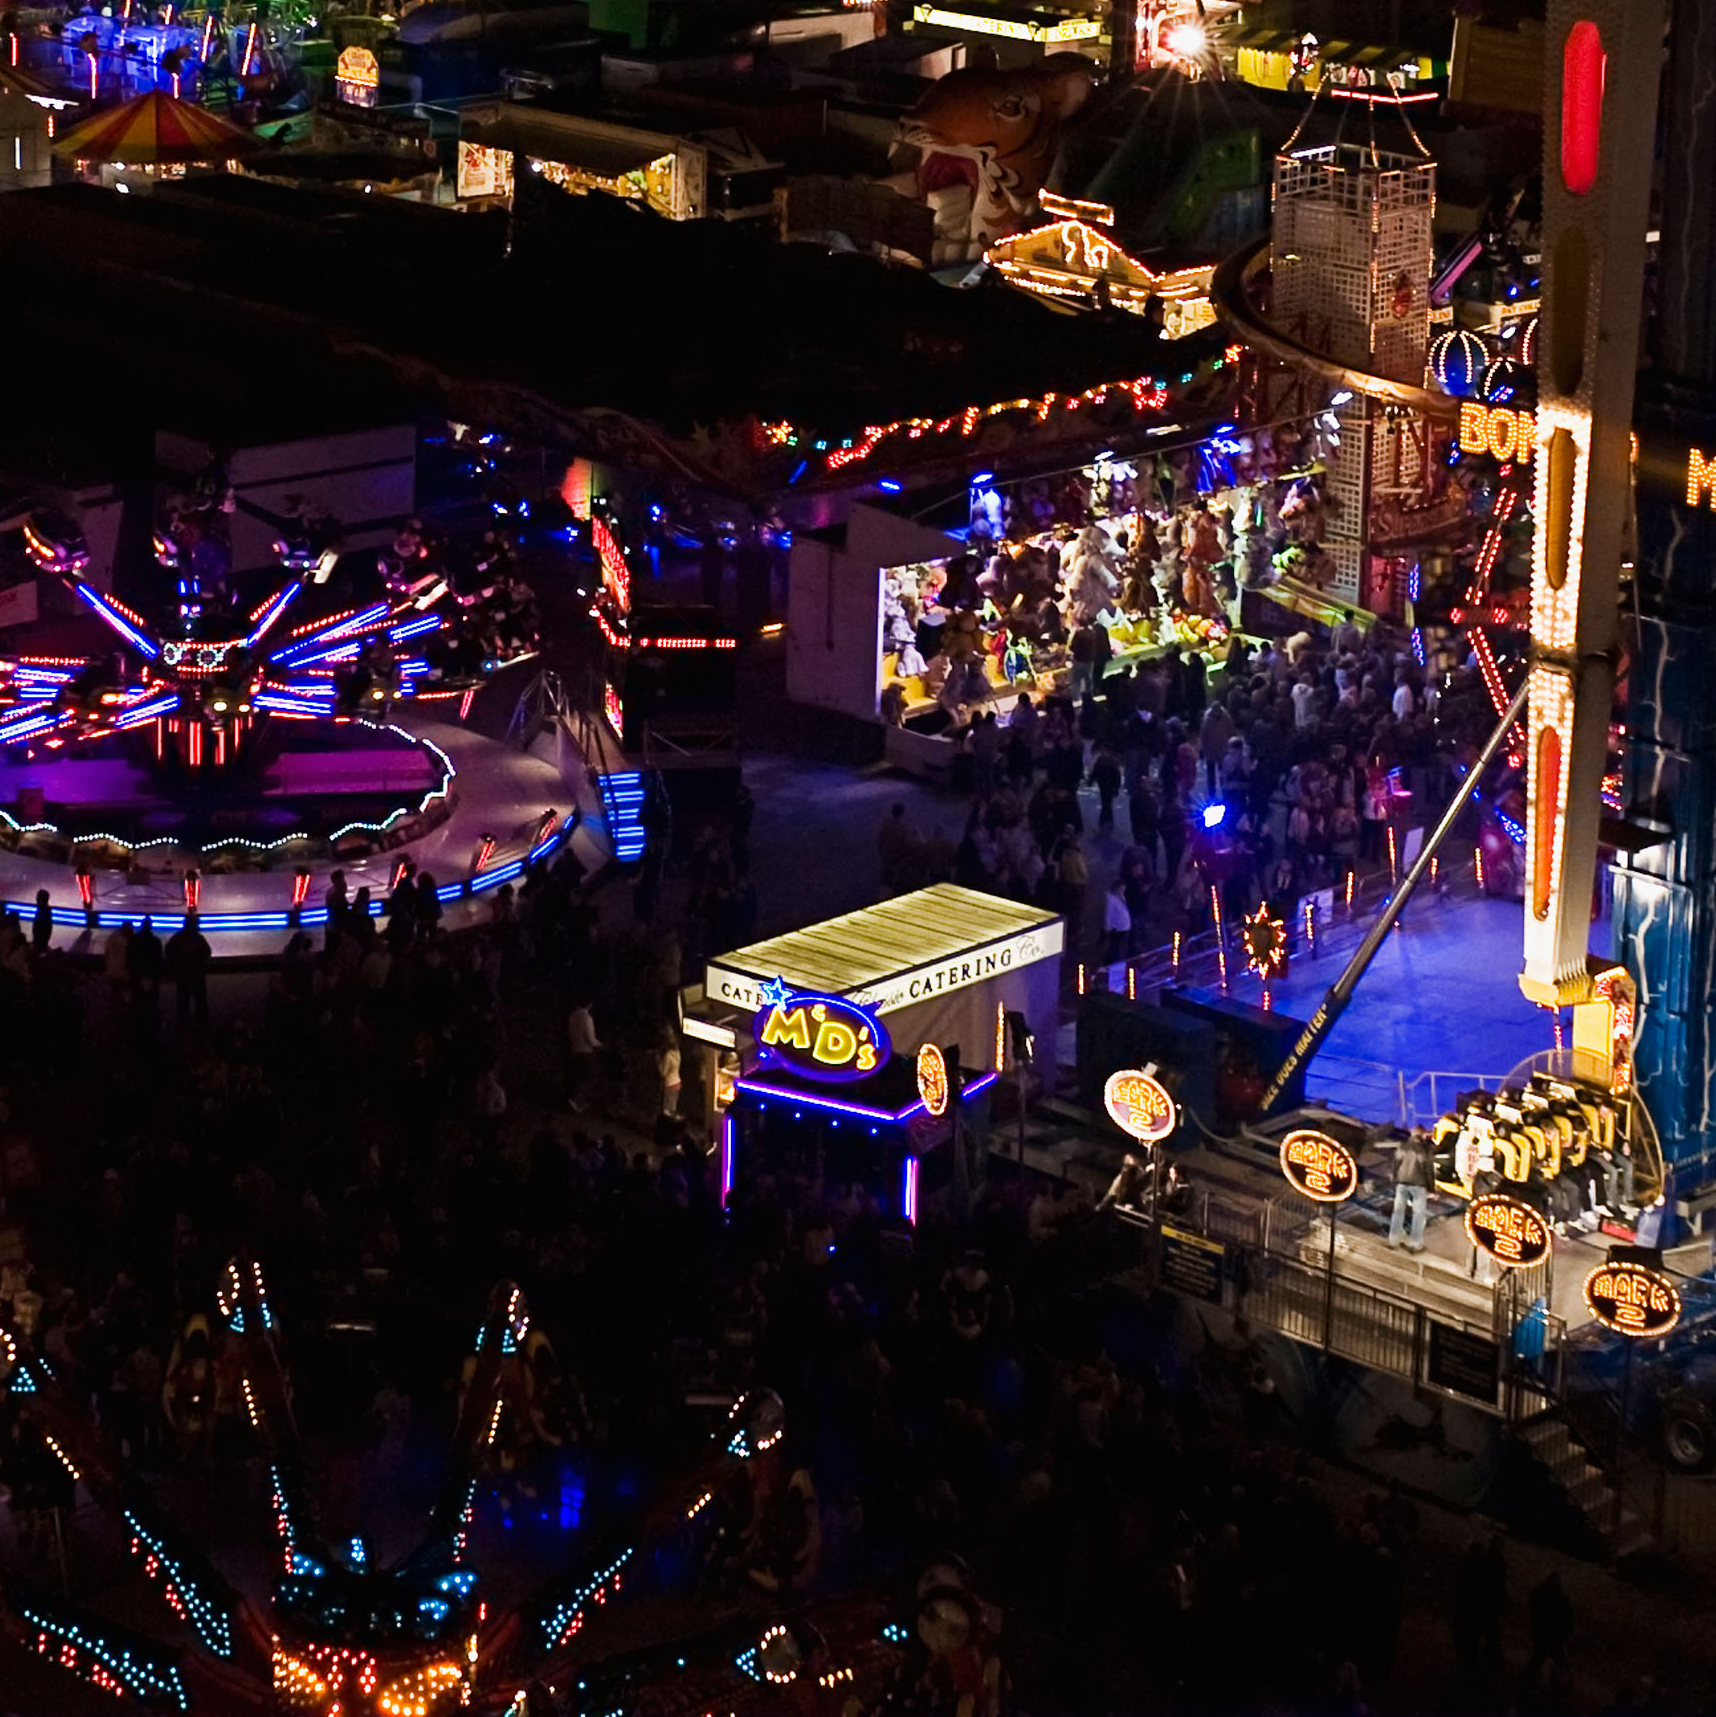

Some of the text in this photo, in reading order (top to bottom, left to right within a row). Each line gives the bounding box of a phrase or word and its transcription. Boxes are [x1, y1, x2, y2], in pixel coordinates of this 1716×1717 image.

[909, 949, 1012, 999] CATERING
[721, 983, 763, 1006] CATE
[1475, 1205, 1542, 1245] MARK
[1494, 1233, 1522, 1260] 2
[1594, 1273, 1670, 1313] MARK
[1615, 1301, 1647, 1328] 2
